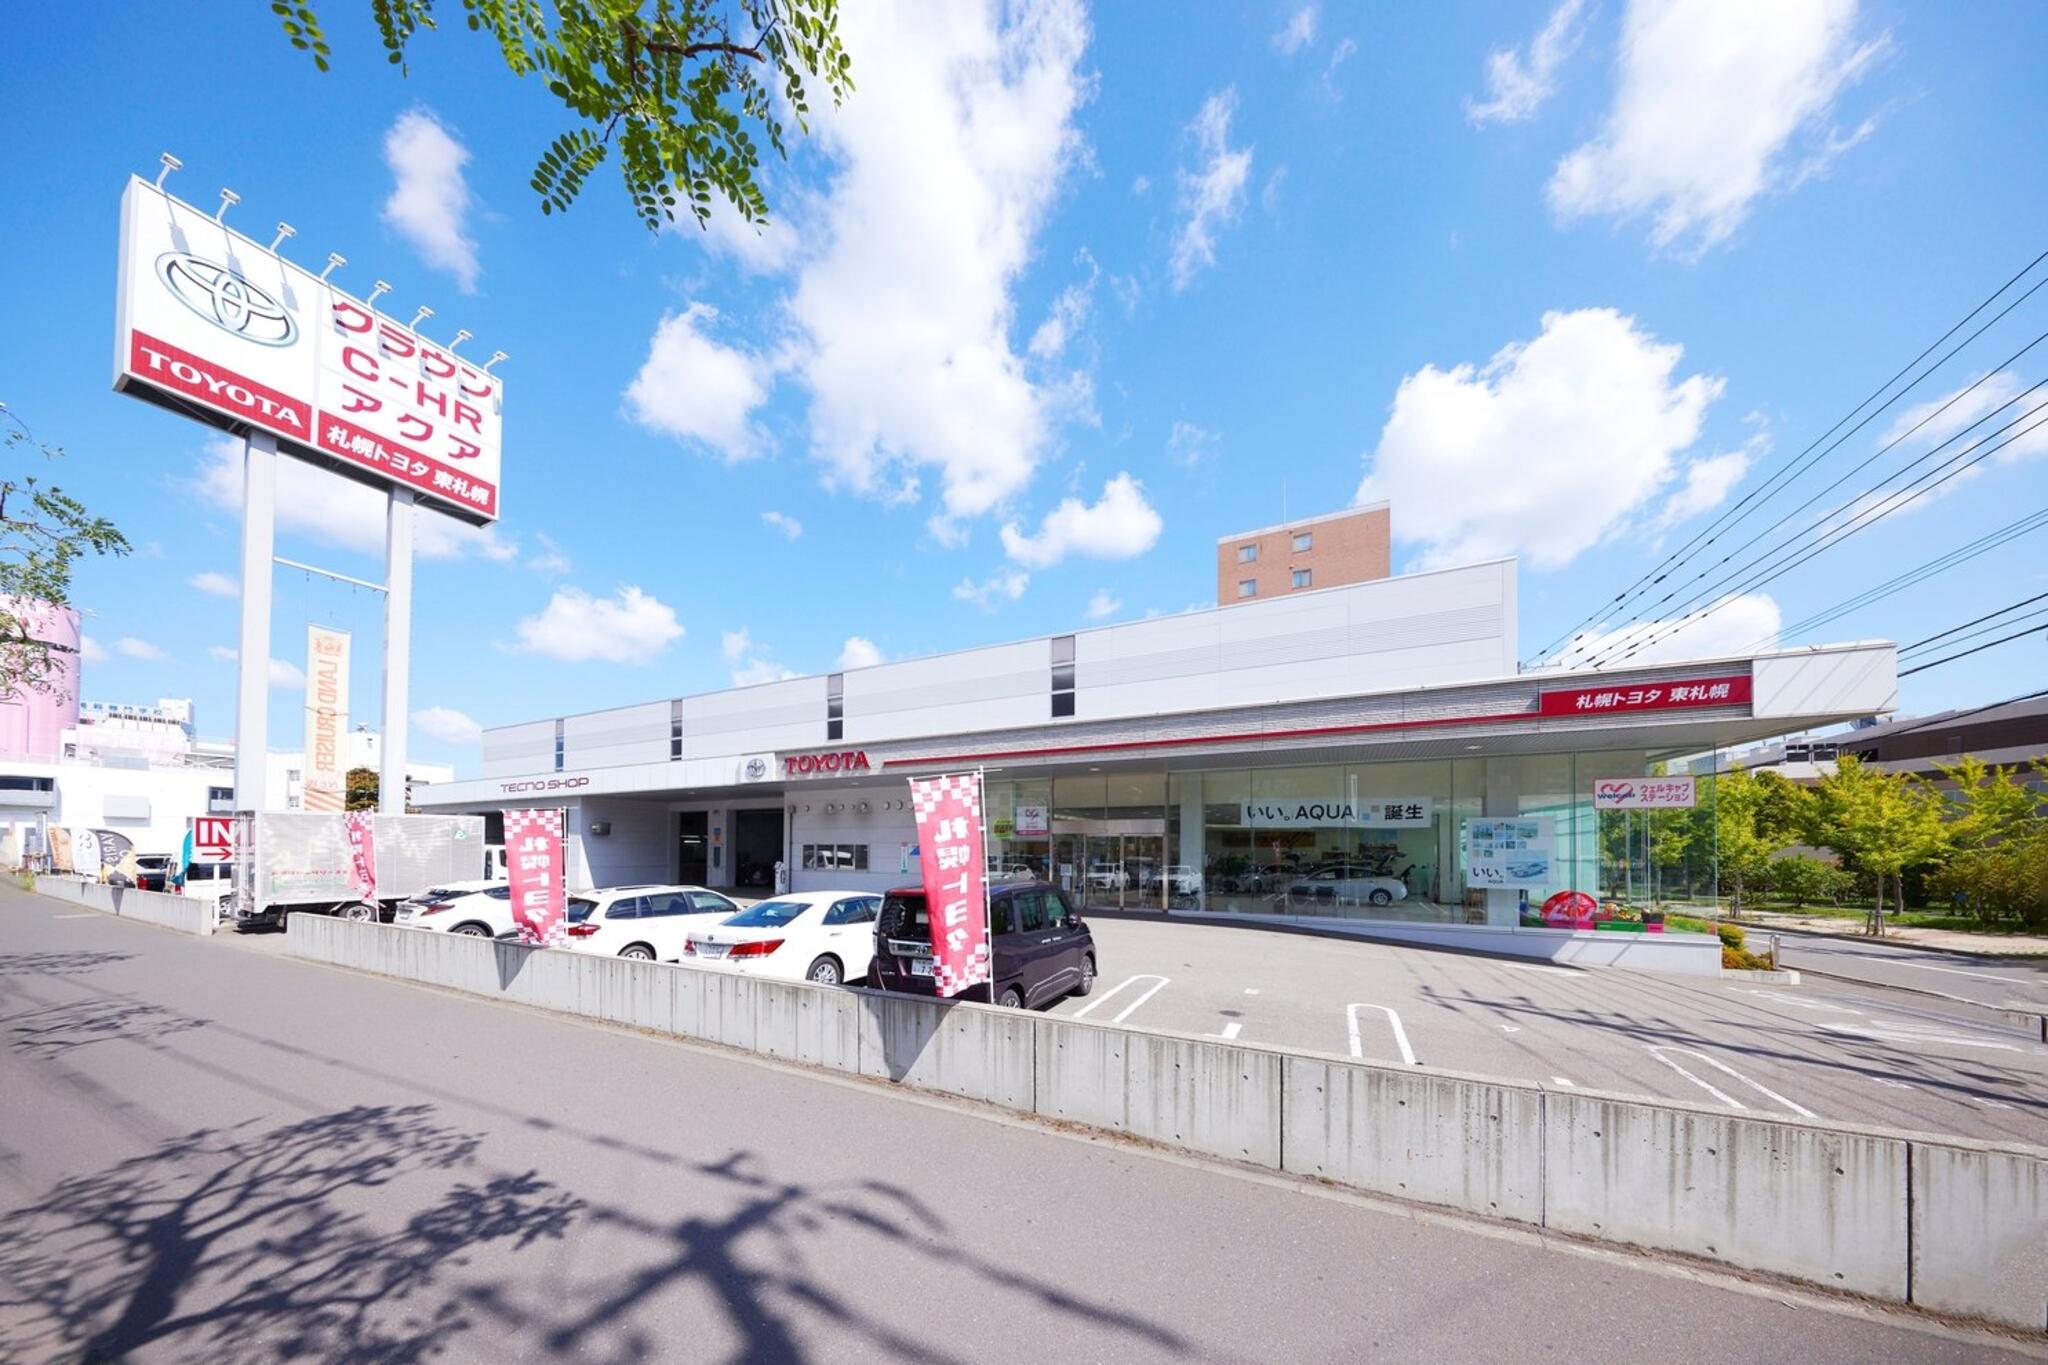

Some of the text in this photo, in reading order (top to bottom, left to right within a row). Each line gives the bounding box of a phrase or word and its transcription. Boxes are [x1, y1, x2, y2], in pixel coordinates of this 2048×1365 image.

[333, 301, 492, 399] クラウン
[140, 346, 303, 429] TOYOTA
[342, 346, 482, 435] C-HR
[341, 383, 481, 460] アクア
[327, 425, 490, 506] 札幌トヨタ 東札幌
[1576, 683, 1731, 709] 札幌トヨタ 東札幌
[500, 777, 590, 792] TECNO SHOP
[784, 750, 870, 773] TOYOTA
[199, 821, 236, 844] IN
[1384, 804, 1425, 820] 誕生
